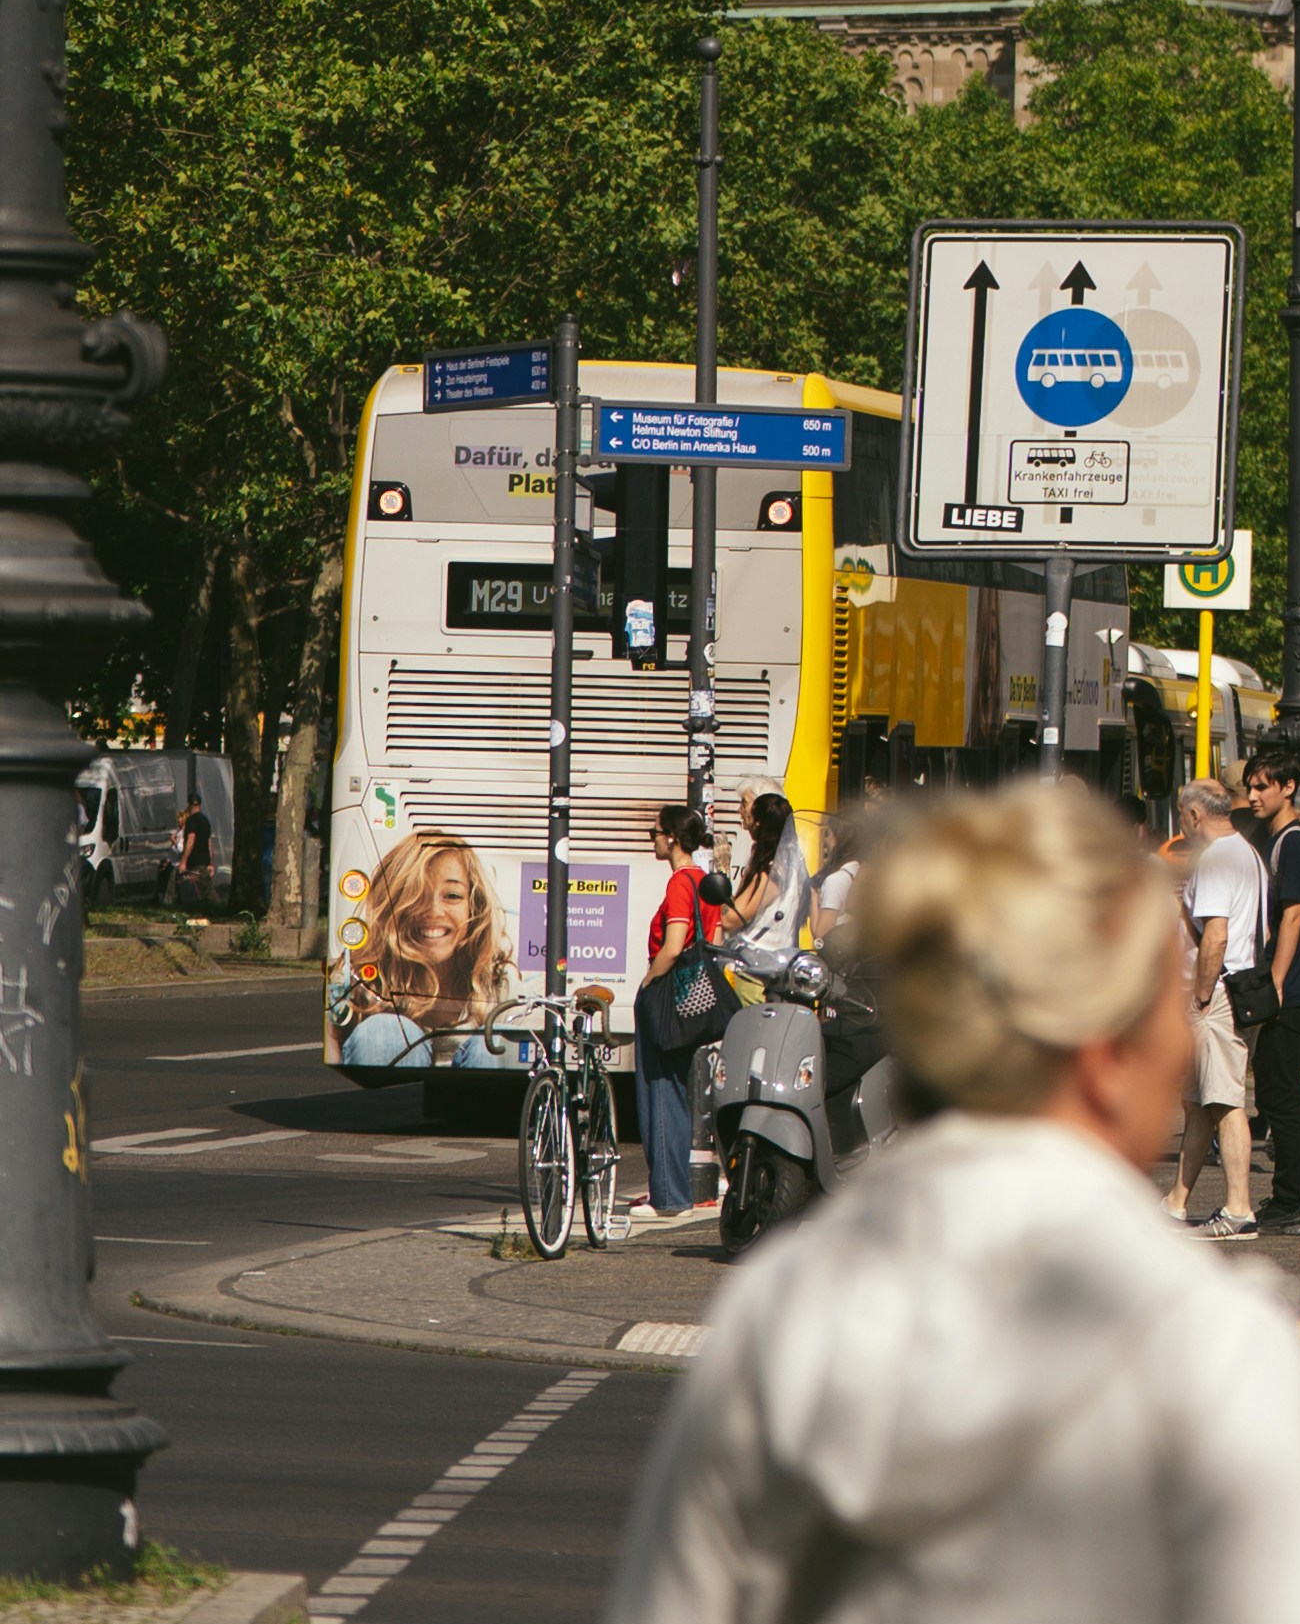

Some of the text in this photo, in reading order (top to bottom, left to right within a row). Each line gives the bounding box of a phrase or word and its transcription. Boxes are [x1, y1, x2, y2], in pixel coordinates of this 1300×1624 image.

[632, 412, 672, 425] Museum
[673, 413, 687, 425] für
[687, 414, 734, 428] Fotografie
[803, 419, 821, 431] 650
[822, 422, 832, 431] m
[632, 424, 738, 441] Helmut Newton Stiftung
[631, 438, 831, 457] C/O Berlin im Amerika Haus 500 m
[454, 446, 529, 469] Dafür,
[508, 474, 557, 494] Plat
[1014, 470, 1124, 485] Krankenfahrzeuge
[1042, 487, 1094, 498] TAXI frei
[951, 507, 1018, 528] LIEBE
[471, 579, 523, 612] M29
[576, 880, 618, 894] Berlin
[585, 905, 605, 916] und
[586, 918, 603, 928] mit
